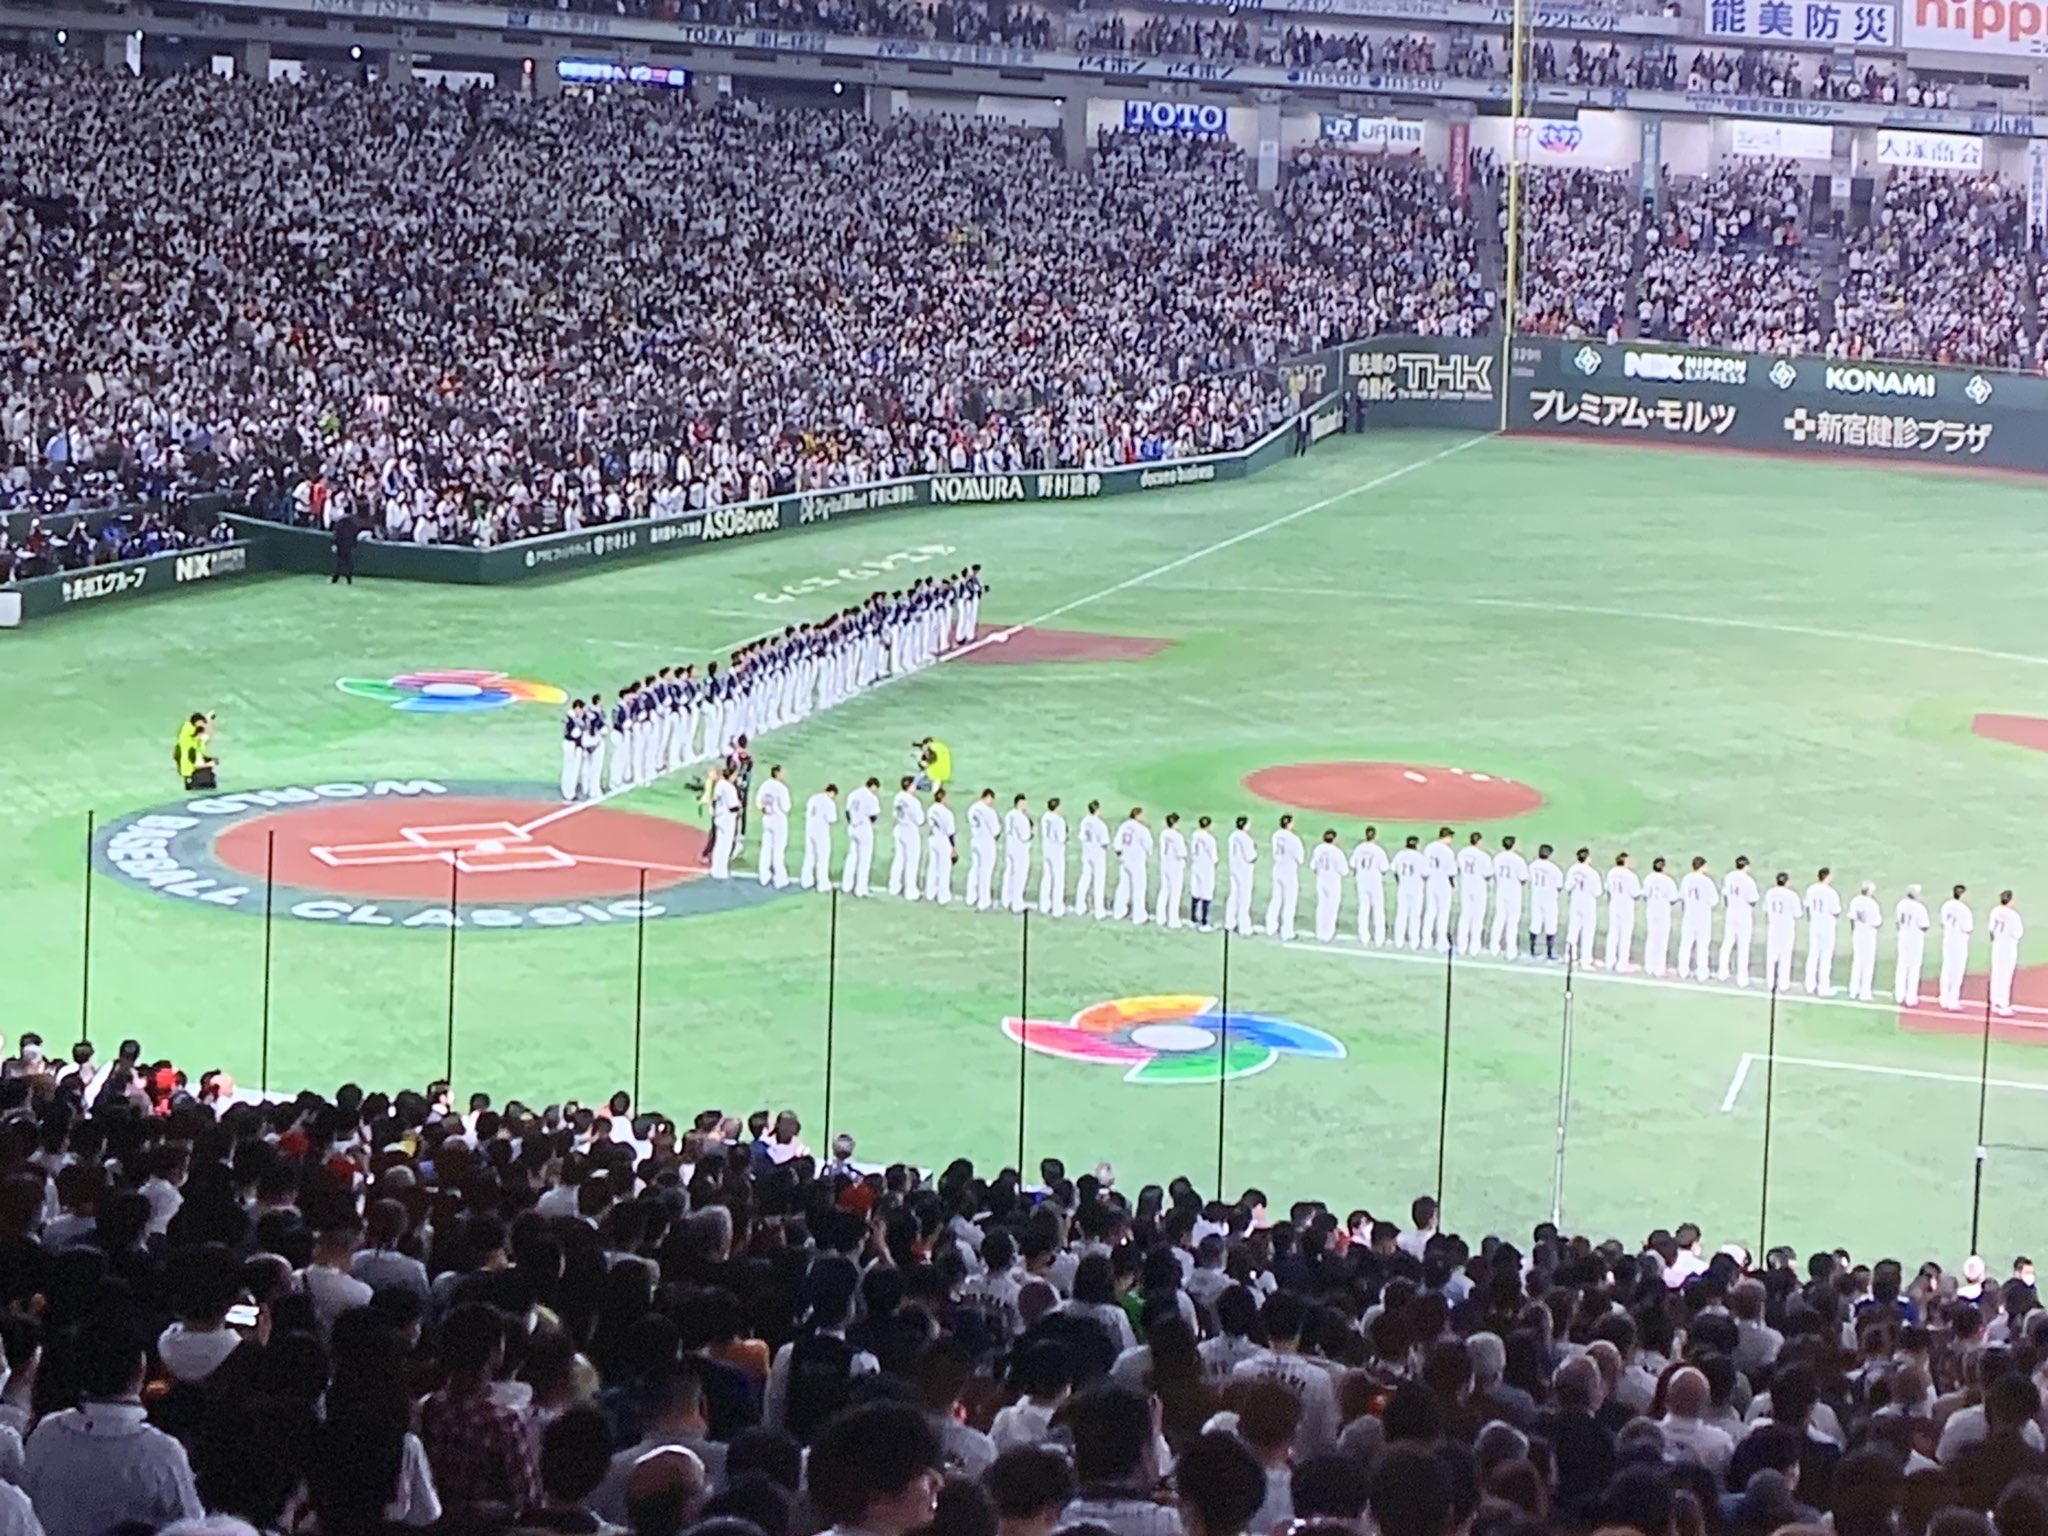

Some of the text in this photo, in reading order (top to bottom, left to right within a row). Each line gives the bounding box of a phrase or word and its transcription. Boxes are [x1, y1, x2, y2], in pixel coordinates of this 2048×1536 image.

[1711, 0, 1887, 43] 能美防災
[1916, 0, 2048, 42] nipp
[1128, 101, 1223, 127] TOTO
[1399, 353, 1493, 391] THK
[1825, 367, 1936, 398] KONAMI
[1530, 389, 1737, 435] プレミアム・モルツ
[1815, 411, 1993, 454] 新宿健診プラザ
[930, 475, 1025, 502] NOMURA
[107, 779, 668, 928] WORLD BASEBALL CLASSIC
